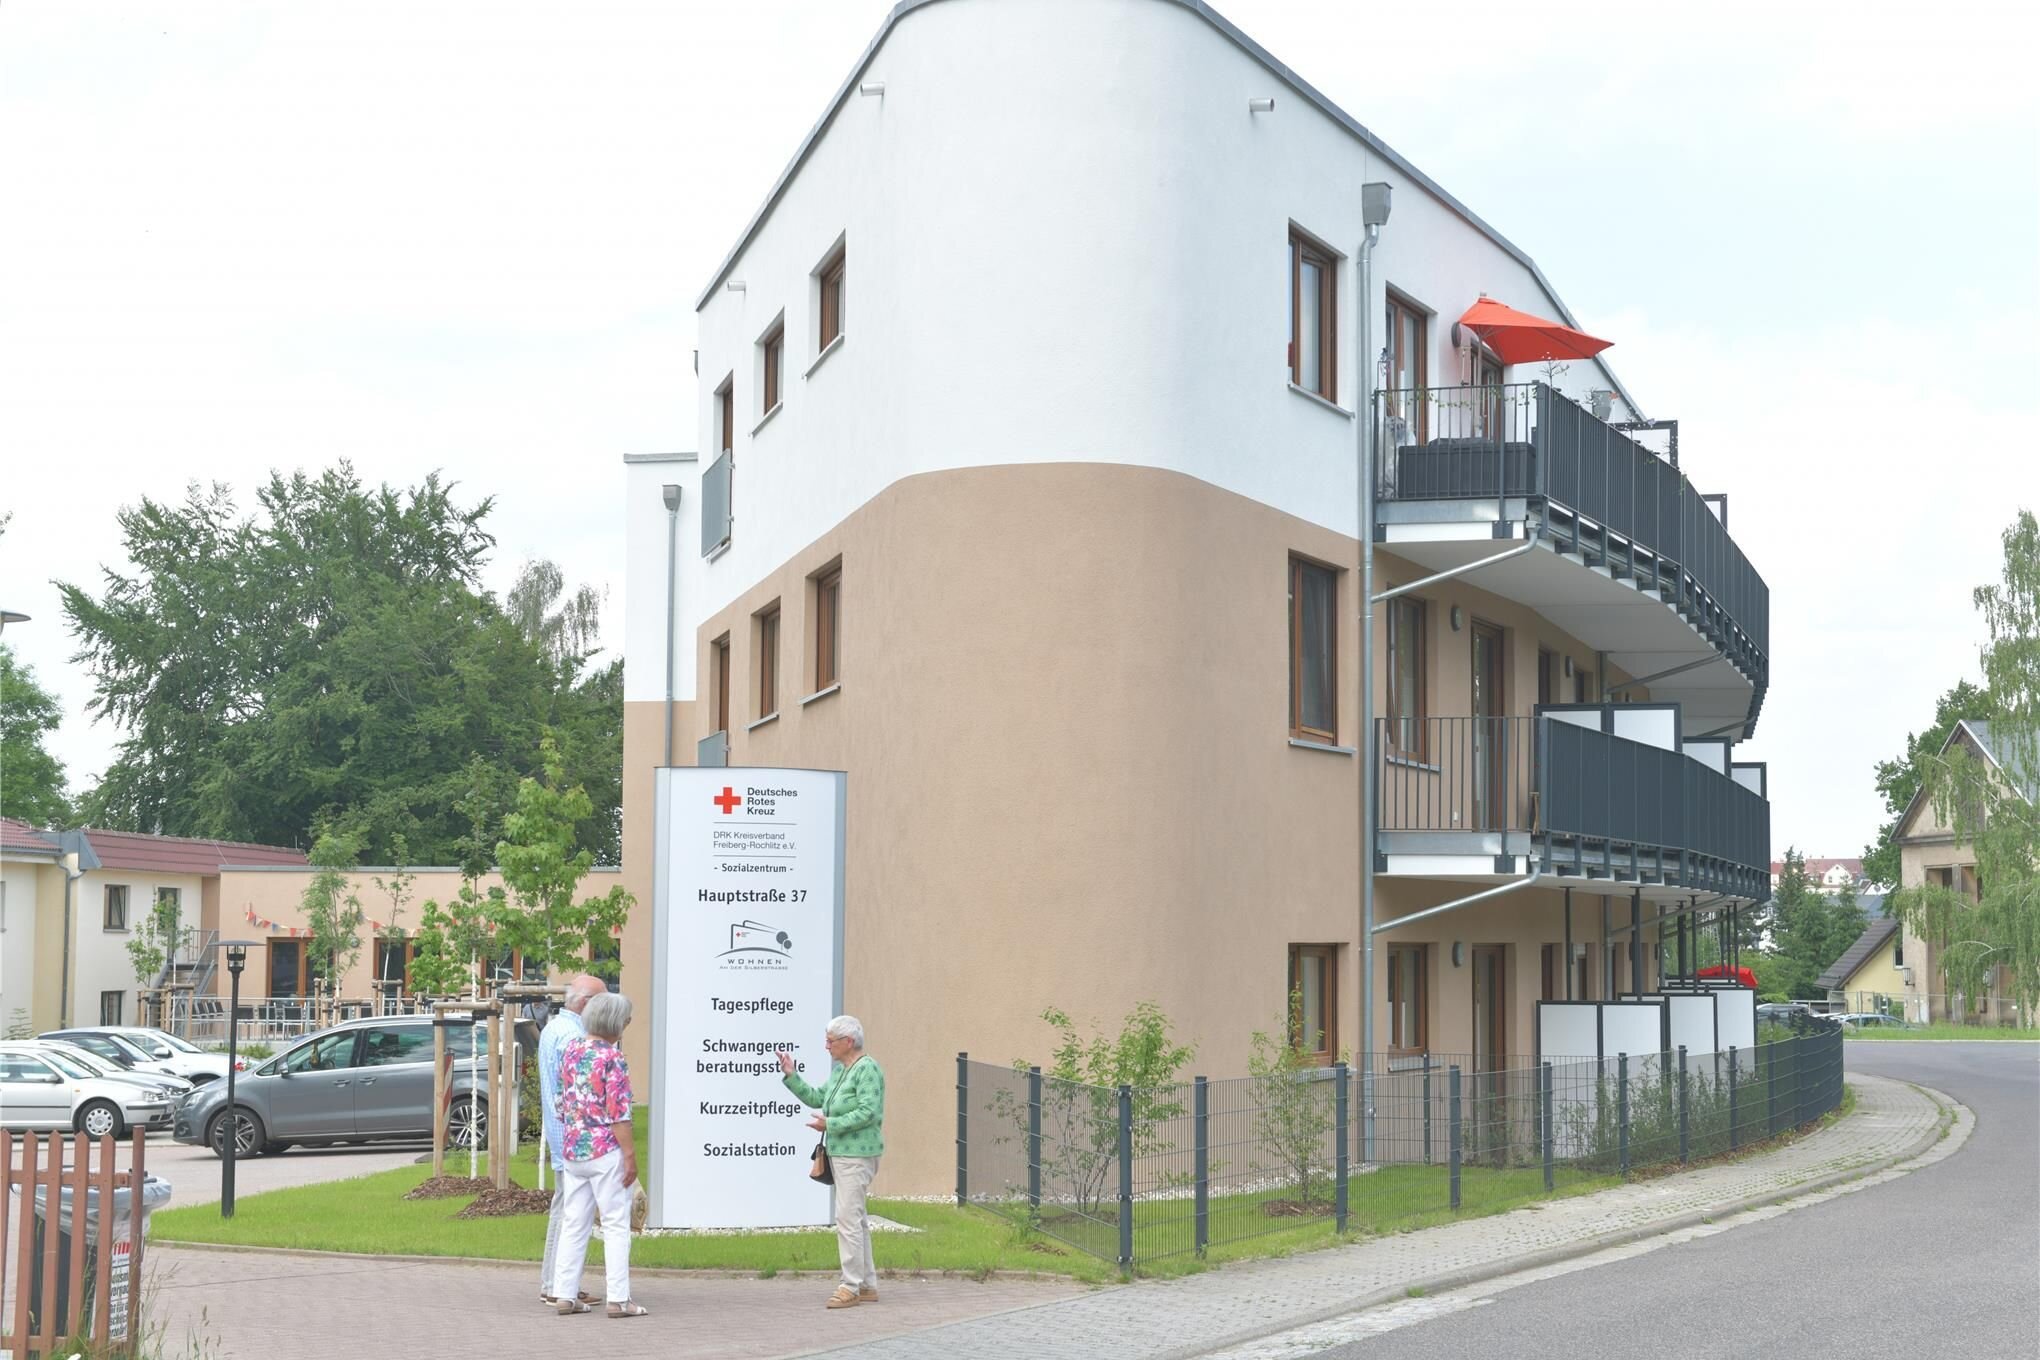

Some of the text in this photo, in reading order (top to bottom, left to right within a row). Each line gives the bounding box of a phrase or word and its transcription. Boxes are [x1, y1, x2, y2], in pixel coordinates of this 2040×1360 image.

[747, 787, 798, 797] Deutsches
[747, 796, 775, 806] Rotes
[747, 806, 775, 816] Kreuz
[713, 831, 785, 840] DRK Kreisverband
[713, 840, 797, 850] Freiberg-Rochlitz e.V.
[721, 862, 787, 873] Sozialzentrum
[698, 888, 807, 905] Hauptstraße 37
[711, 997, 794, 1014] Tagespflege
[702, 1038, 800, 1056] Schwangeren-
[696, 1058, 806, 1077] beratungsstle
[700, 1101, 801, 1118] Kurzzeitpflege
[703, 1143, 796, 1157] Sozialstation
